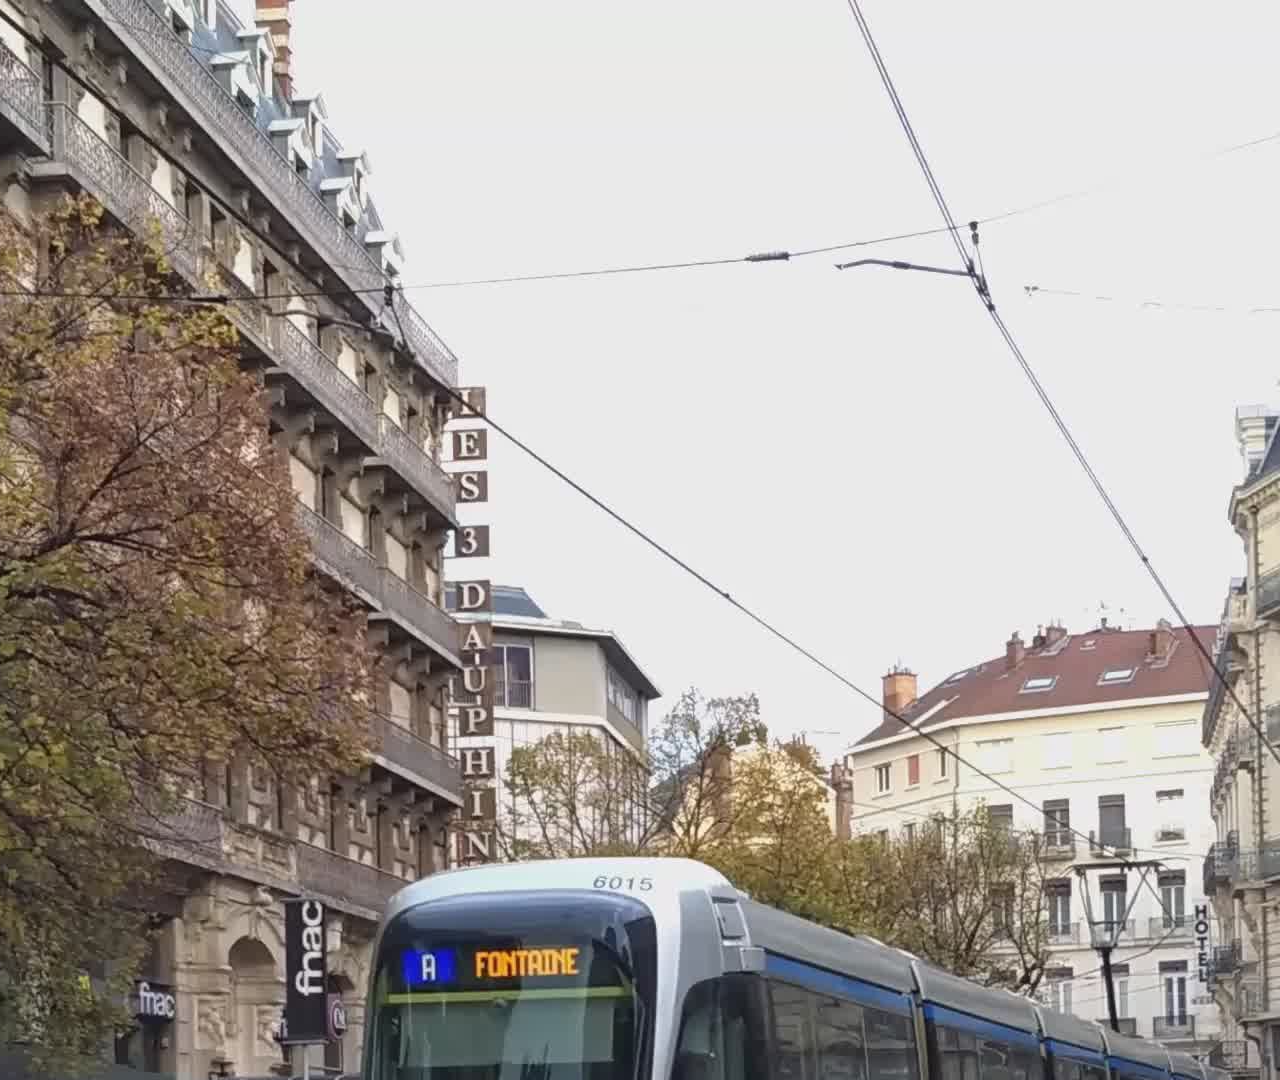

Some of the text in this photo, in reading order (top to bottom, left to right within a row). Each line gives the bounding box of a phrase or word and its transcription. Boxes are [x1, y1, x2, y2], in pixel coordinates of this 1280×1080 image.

[457, 388, 481, 500] LES
[460, 527, 478, 554] 3
[592, 875, 654, 891] 6015
[295, 900, 323, 997] fnac
[1194, 904, 1209, 983] HOTEL
[422, 947, 580, 981] A FONTAINE
[139, 981, 175, 1018] fnac
